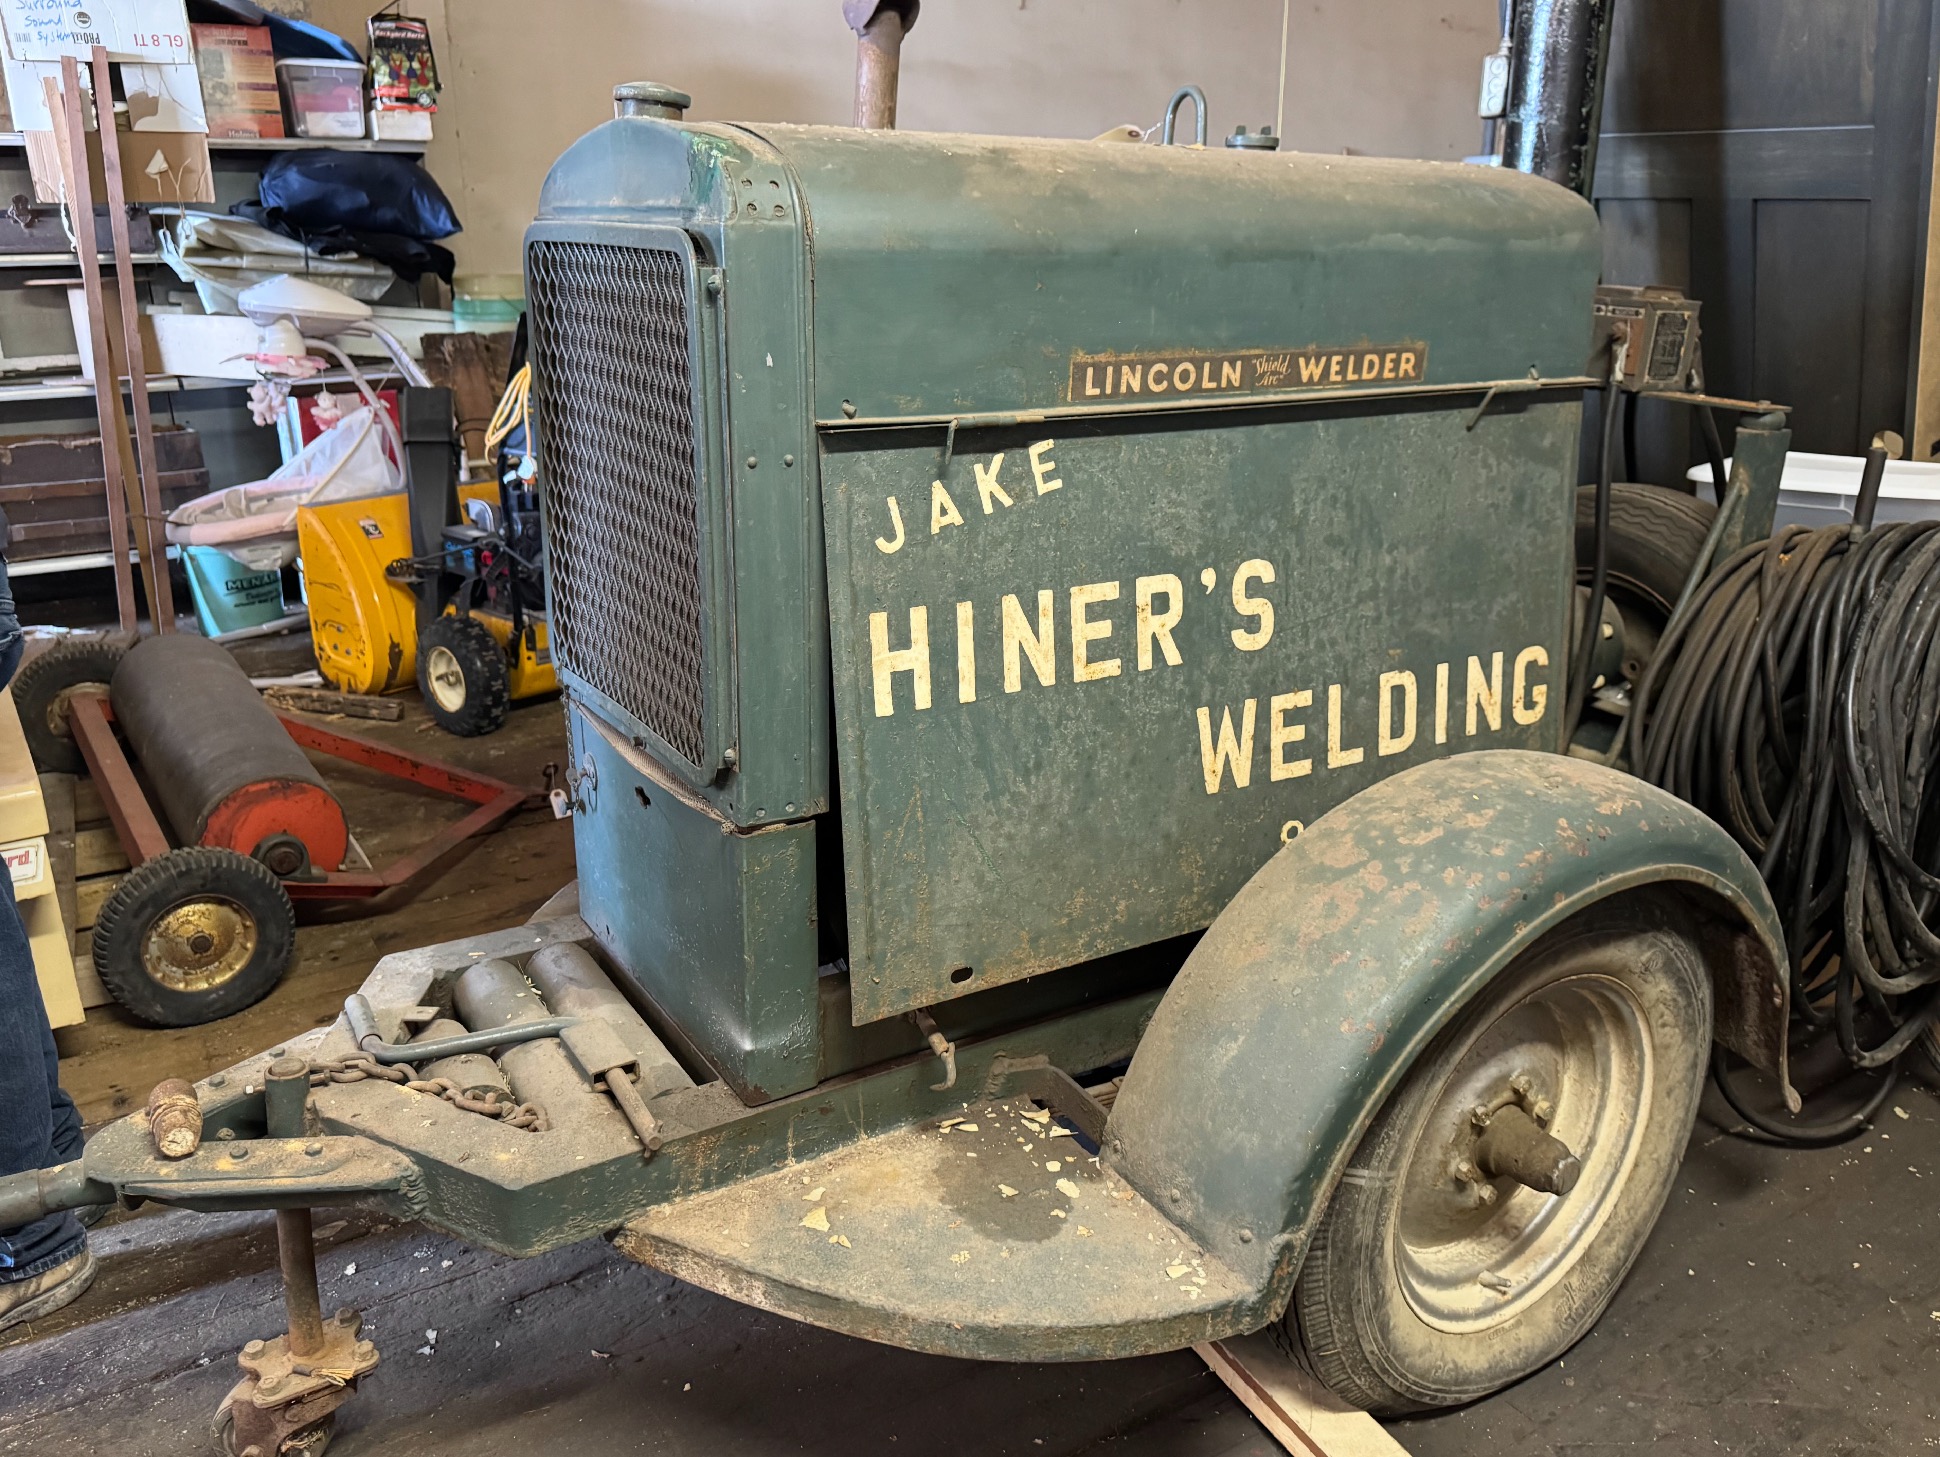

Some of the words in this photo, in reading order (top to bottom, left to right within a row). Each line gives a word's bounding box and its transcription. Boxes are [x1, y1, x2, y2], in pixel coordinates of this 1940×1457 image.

[1085, 360, 1242, 396] LINCOLN
[1298, 352, 1416, 384] WELDER
[875, 439, 1063, 554] JAKE
[869, 558, 1276, 717] HINER'S
[1196, 645, 1549, 795] WELDING
